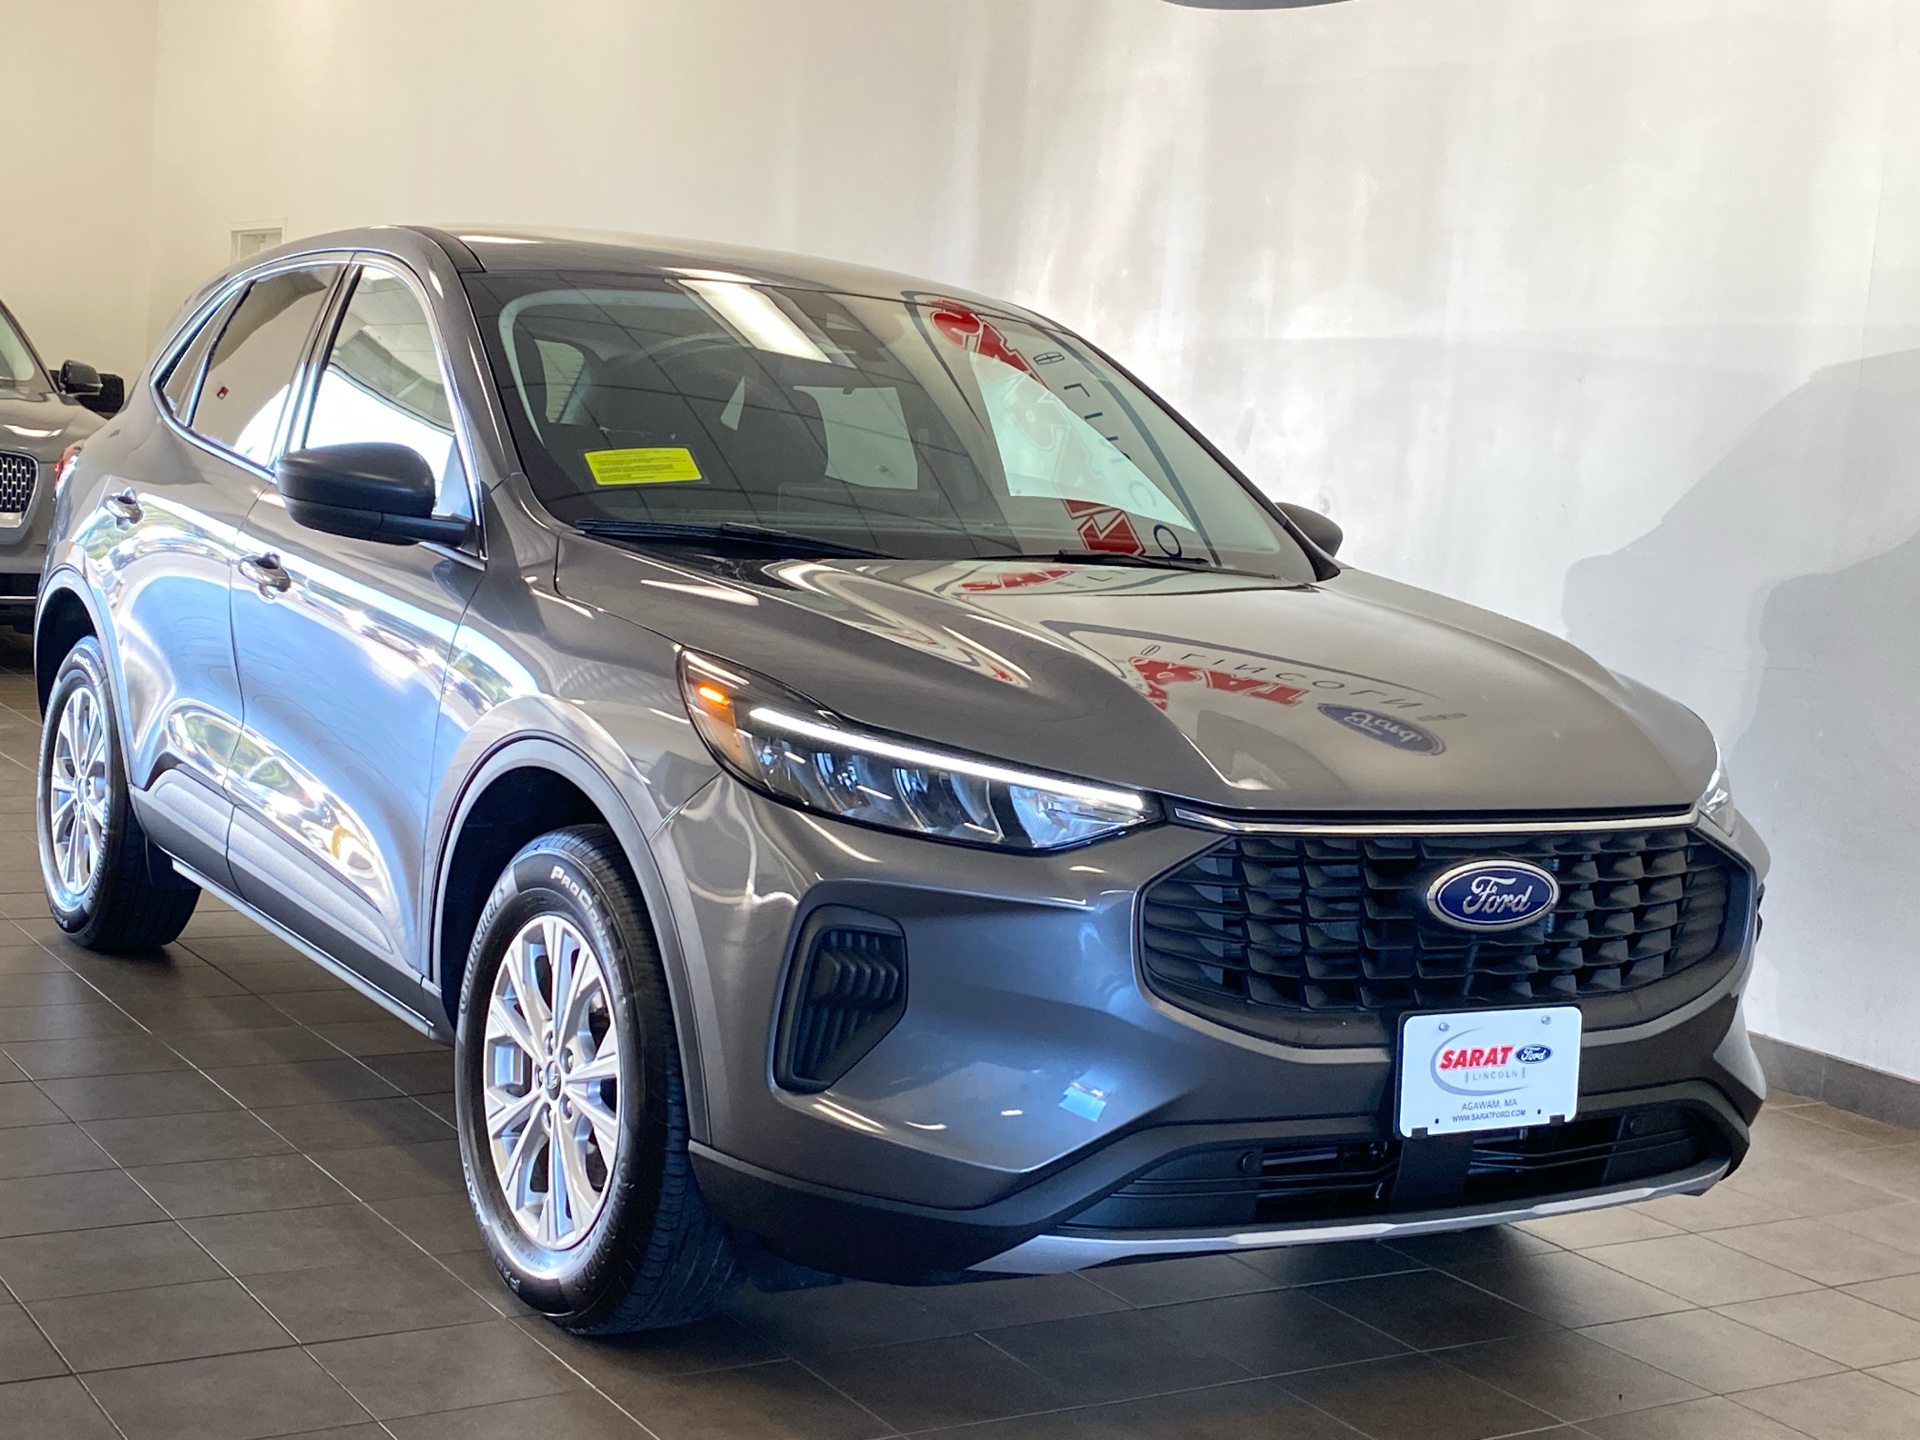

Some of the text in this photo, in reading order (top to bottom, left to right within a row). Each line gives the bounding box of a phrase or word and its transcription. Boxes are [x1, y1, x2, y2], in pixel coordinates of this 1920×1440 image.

[1462, 875, 1533, 915] Ford
[1438, 1044, 1515, 1070] SARAT
[1472, 1069, 1519, 1082] LINCOLN
[1461, 1098, 1518, 1112] AGAWAM, MA
[1451, 1109, 1526, 1123] WWW.SARATFORD.COM
